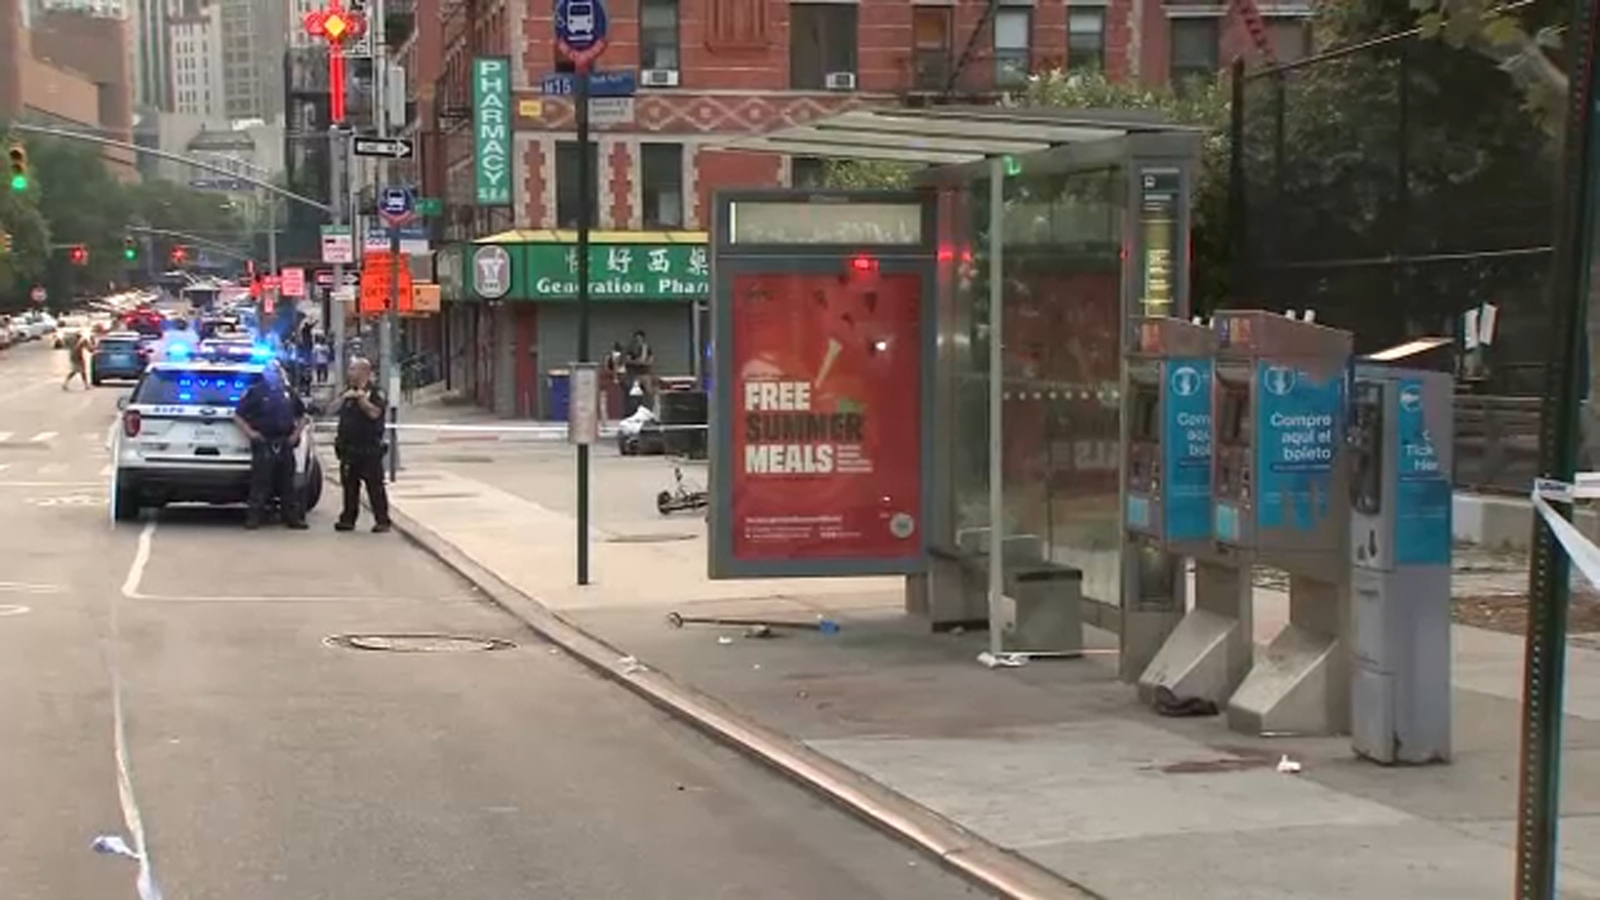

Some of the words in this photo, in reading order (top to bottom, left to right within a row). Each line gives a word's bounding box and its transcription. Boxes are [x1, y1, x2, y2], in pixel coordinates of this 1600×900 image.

[480, 61, 504, 185] PHARMACY
[745, 382, 810, 411] FREE
[746, 412, 864, 441] SUMMER
[1270, 412, 1332, 428] Compre
[1317, 430, 1331, 443] el
[745, 444, 833, 474] MEALS
[1283, 446, 1331, 461] boleto
